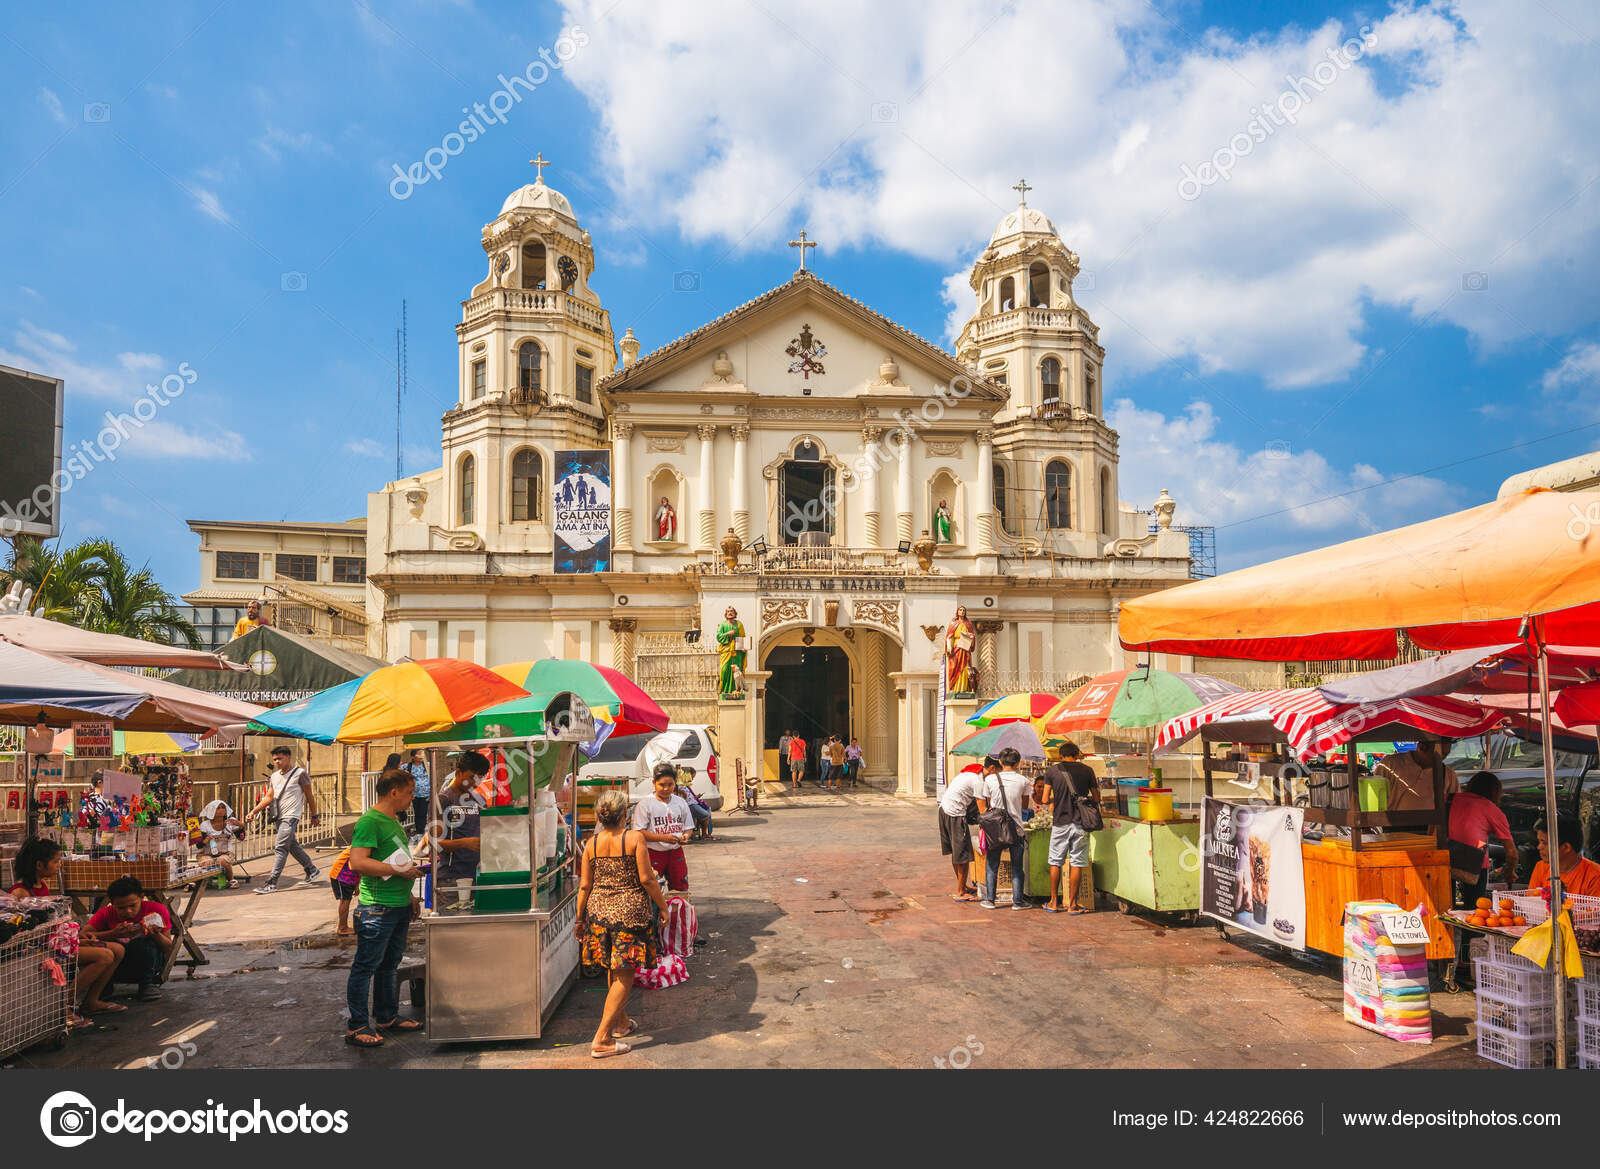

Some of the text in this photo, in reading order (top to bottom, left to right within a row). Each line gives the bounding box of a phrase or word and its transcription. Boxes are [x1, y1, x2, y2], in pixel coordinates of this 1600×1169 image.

[556, 511, 609, 520] IGALANG
[555, 523, 610, 531] AMA AT INA
[819, 578, 835, 590] NG
[842, 578, 905, 591] NAZARENO
[226, 691, 251, 701] BASILICA
[251, 691, 260, 701] OF
[260, 691, 270, 701] THE
[271, 691, 289, 701] BLACK
[540, 910, 563, 952] FRESH
